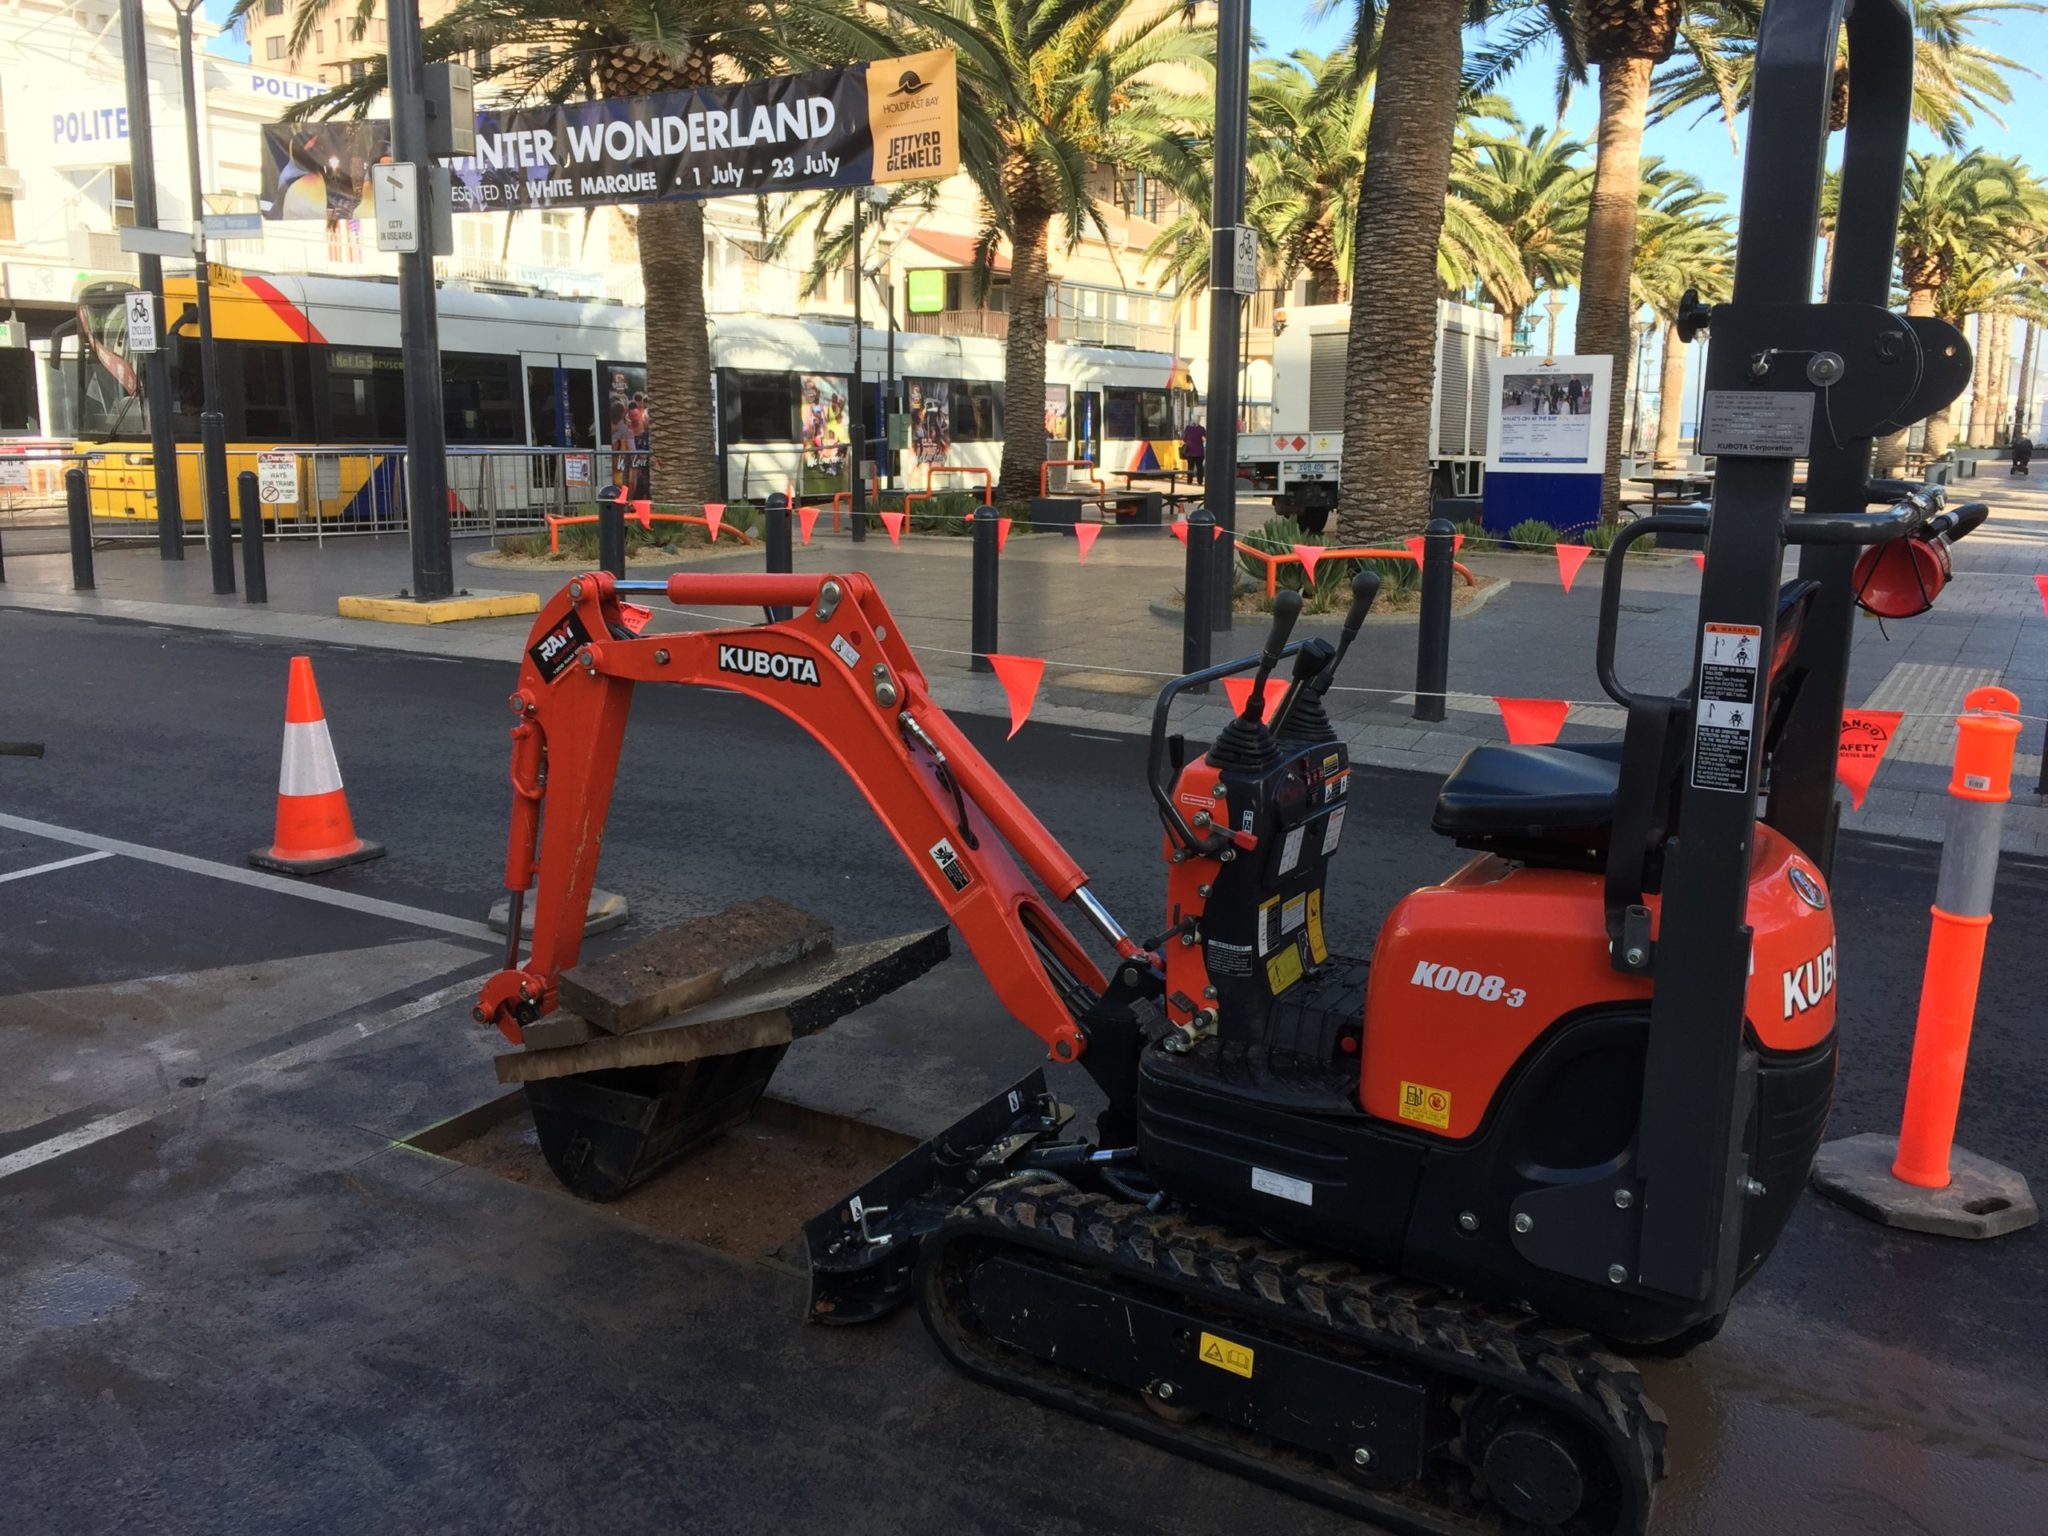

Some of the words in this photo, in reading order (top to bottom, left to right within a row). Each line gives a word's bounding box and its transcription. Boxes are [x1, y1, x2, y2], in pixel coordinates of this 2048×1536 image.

[883, 99, 924, 114] HOLDFAST
[925, 96, 940, 108] BAY
[566, 96, 836, 163] WONDERLAND
[887, 131, 941, 159] JETTYRD
[887, 146, 942, 172] GLENELG
[504, 183, 520, 200] BY
[526, 178, 573, 199] WHITE
[580, 172, 658, 195] MARQUEE
[693, 167, 701, 185] 1
[711, 162, 745, 188] July
[771, 157, 795, 178] 23
[803, 151, 841, 177] July
[388, 220, 403, 229] CCTV
[213, 263, 237, 284] TAXIS
[1717, 443, 1748, 451] KUBOTA
[1749, 444, 1793, 452] Corporation
[538, 620, 575, 662] RAM
[720, 644, 820, 685] KUBOTA
[1842, 719, 1880, 736] ANCO
[1839, 744, 1879, 752] AFETY
[1410, 960, 1527, 1008] K008-3
[1783, 936, 1837, 1020] KUB
